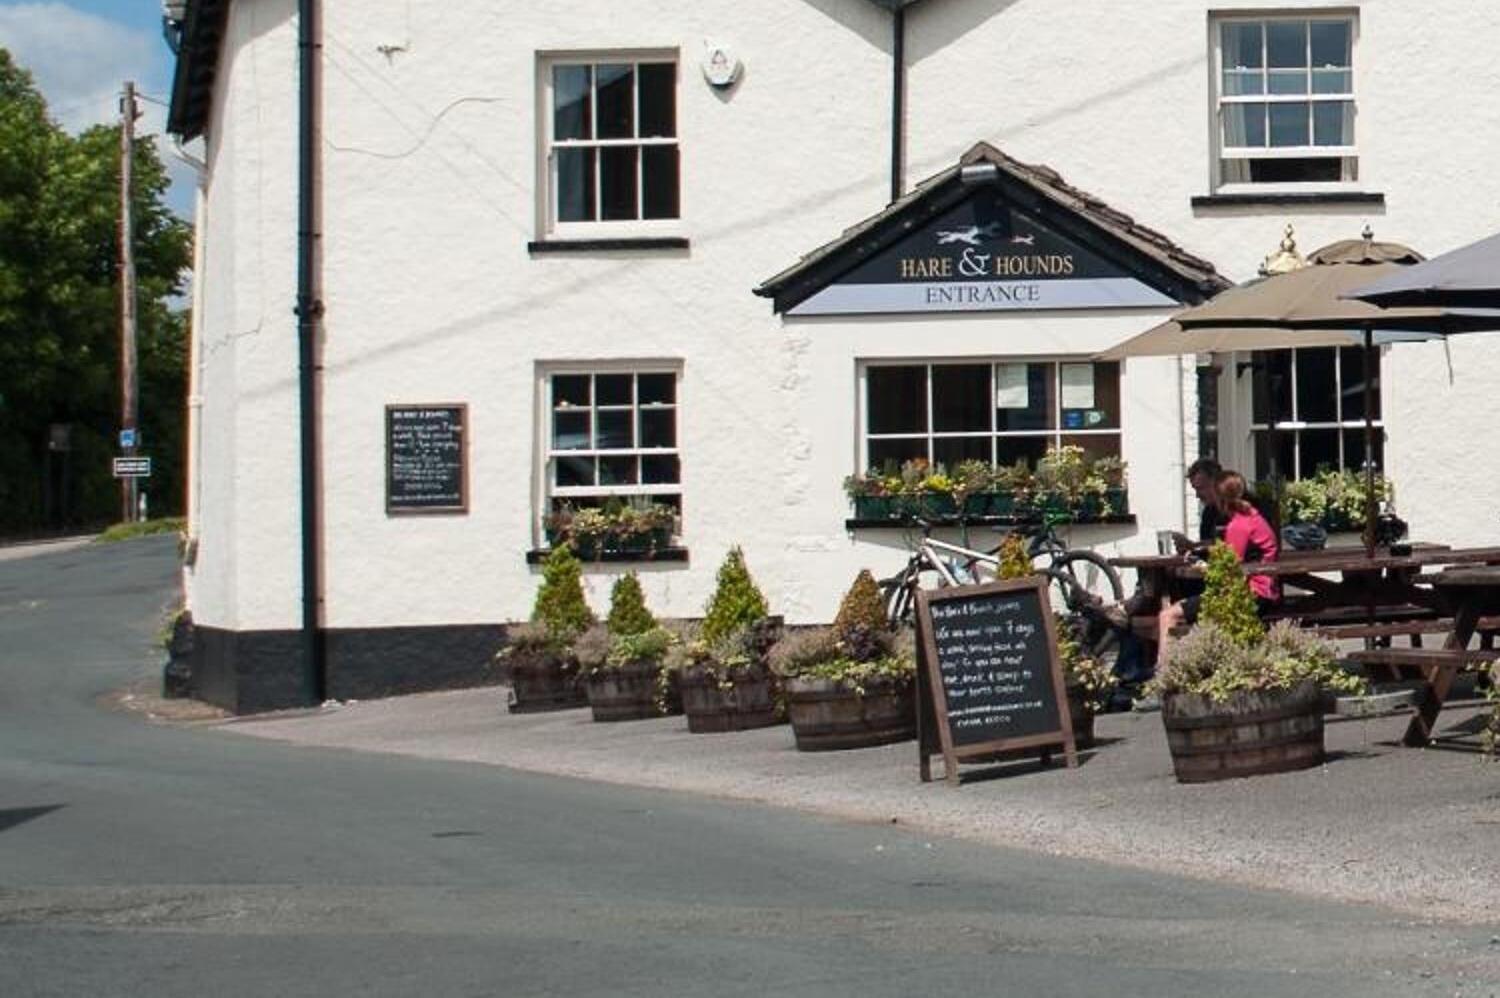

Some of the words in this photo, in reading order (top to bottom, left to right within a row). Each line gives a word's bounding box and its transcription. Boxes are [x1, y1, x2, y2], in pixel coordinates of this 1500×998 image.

[902, 259, 952, 278] HARE
[958, 248, 990, 277] &
[996, 255, 1074, 276] HOUNDS
[926, 285, 1040, 304] ENTRANCE
